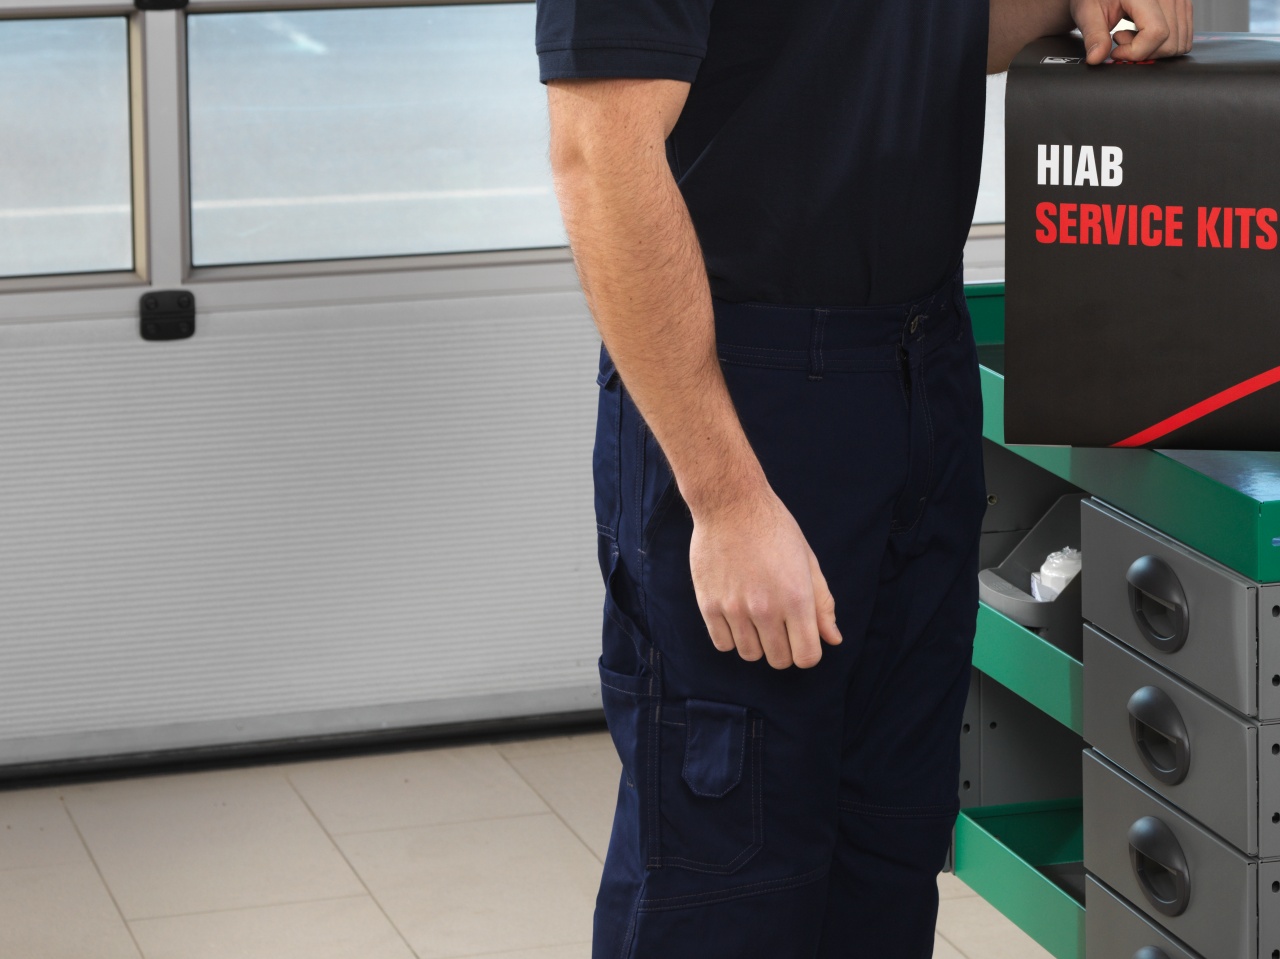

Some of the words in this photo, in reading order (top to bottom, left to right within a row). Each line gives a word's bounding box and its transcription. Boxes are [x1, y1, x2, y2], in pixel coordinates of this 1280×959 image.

[1037, 143, 1124, 187] HIAB
[1035, 201, 1184, 247] SERVICE
[1197, 206, 1279, 251] KITS
